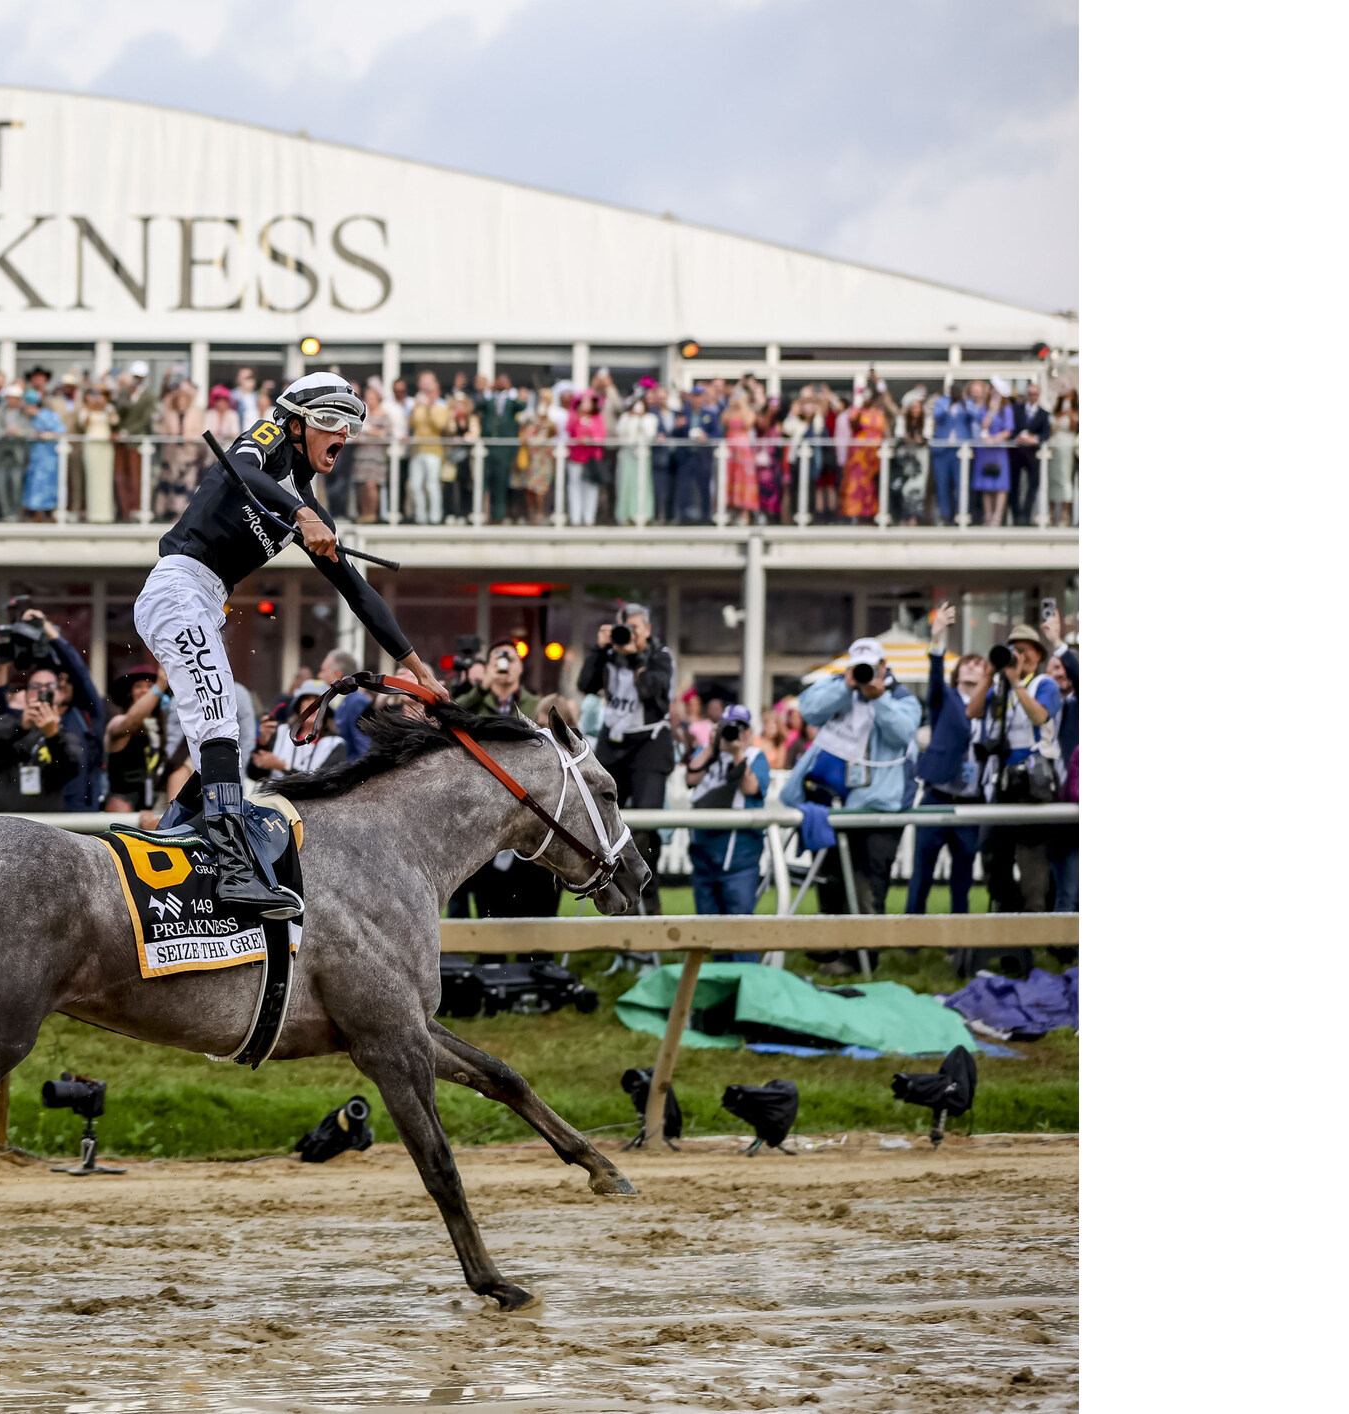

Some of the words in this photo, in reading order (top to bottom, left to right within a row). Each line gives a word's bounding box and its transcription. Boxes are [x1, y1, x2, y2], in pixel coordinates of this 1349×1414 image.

[251, 422, 281, 446] 6
[242, 504, 276, 560] myRaceho
[174, 630, 215, 721] WIPES
[195, 864, 218, 877] GRA
[190, 898, 214, 914] 149
[151, 917, 239, 939] PREAKNESS
[156, 942, 200, 963] SEIZE
[200, 941, 229, 959] THE
